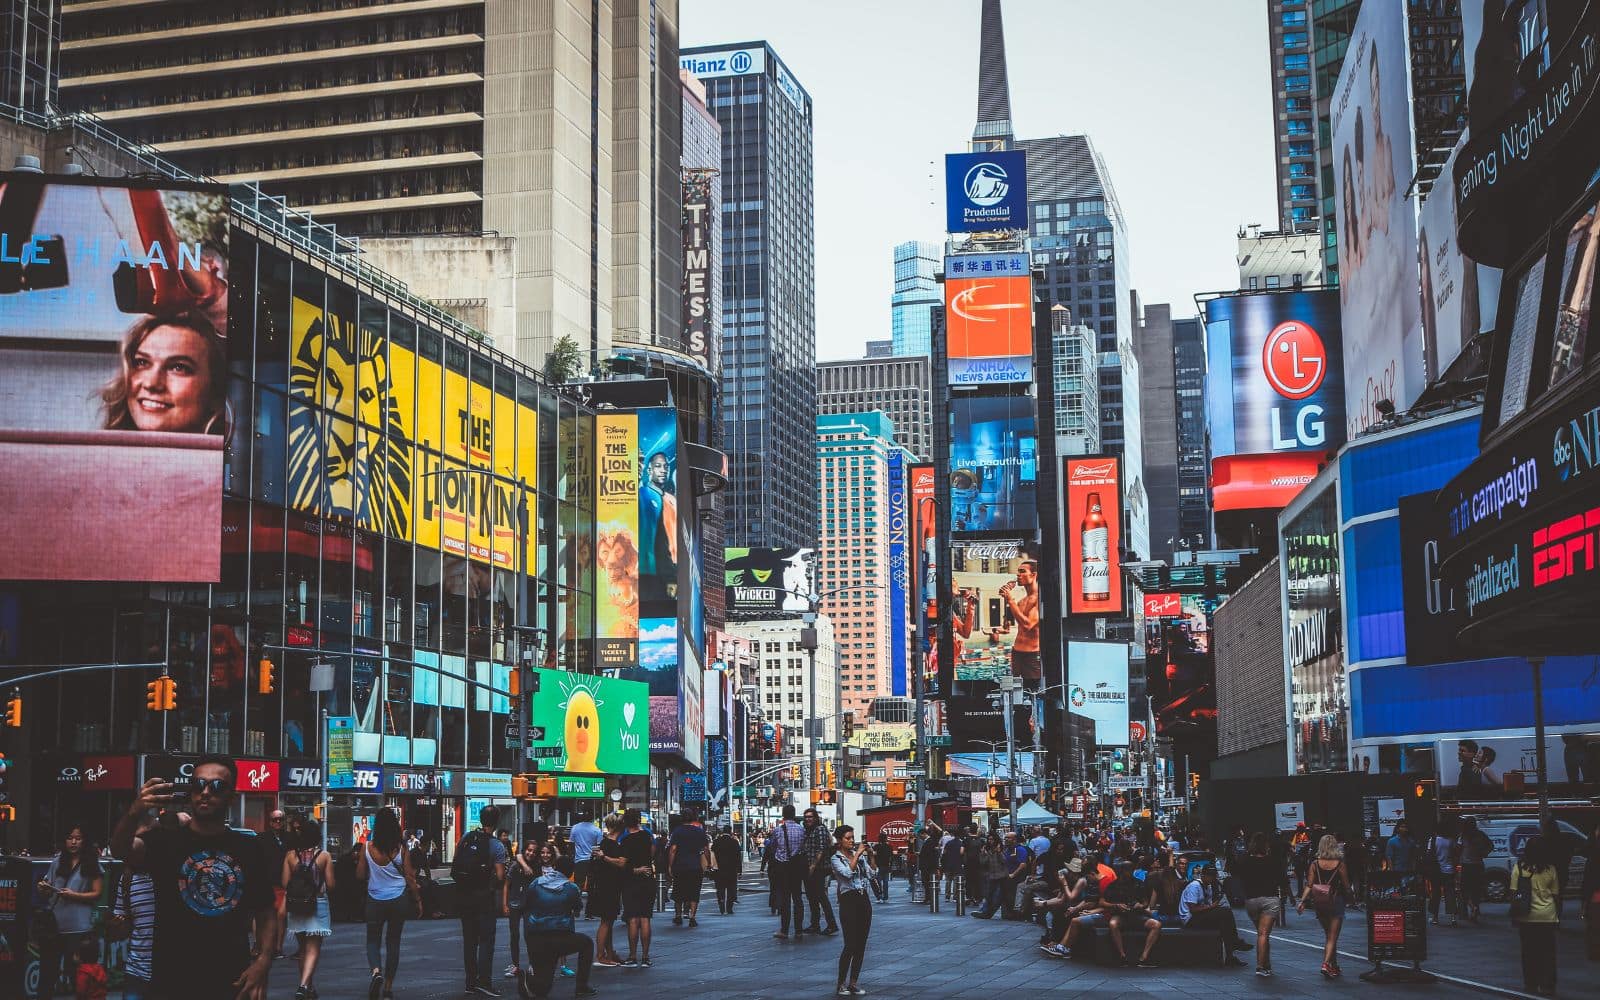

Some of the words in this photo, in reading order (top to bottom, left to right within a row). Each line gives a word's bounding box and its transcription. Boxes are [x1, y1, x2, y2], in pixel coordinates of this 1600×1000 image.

[1460, 151, 1497, 202] ening
[1501, 107, 1544, 165] Night
[1545, 82, 1570, 127] Live
[1571, 62, 1582, 96] in
[964, 206, 1010, 217] Prudential
[75, 236, 202, 272] HAAN
[686, 203, 707, 317] TIMES
[955, 373, 983, 382] NEWS
[986, 371, 1027, 381] AGENCY
[966, 360, 1015, 373] XINHUA
[458, 408, 491, 454] THE
[603, 426, 628, 436] Disney
[1271, 404, 1326, 450] LG
[605, 444, 627, 454] THE
[1554, 439, 1571, 468] abc
[602, 456, 632, 474] LION
[957, 458, 976, 467] Live
[981, 456, 1025, 467] beautiful
[423, 439, 476, 522] LION
[600, 475, 636, 497] KING
[1472, 457, 1539, 521] campaign
[1466, 543, 1520, 617] pitalized
[1146, 596, 1178, 613] Ray-Ban
[1288, 623, 1304, 666] OLD
[1304, 608, 1327, 662] NAVY
[84, 765, 108, 782] Ray-Ban
[248, 764, 271, 788] Ray-Ban
[560, 781, 573, 793] NEW
